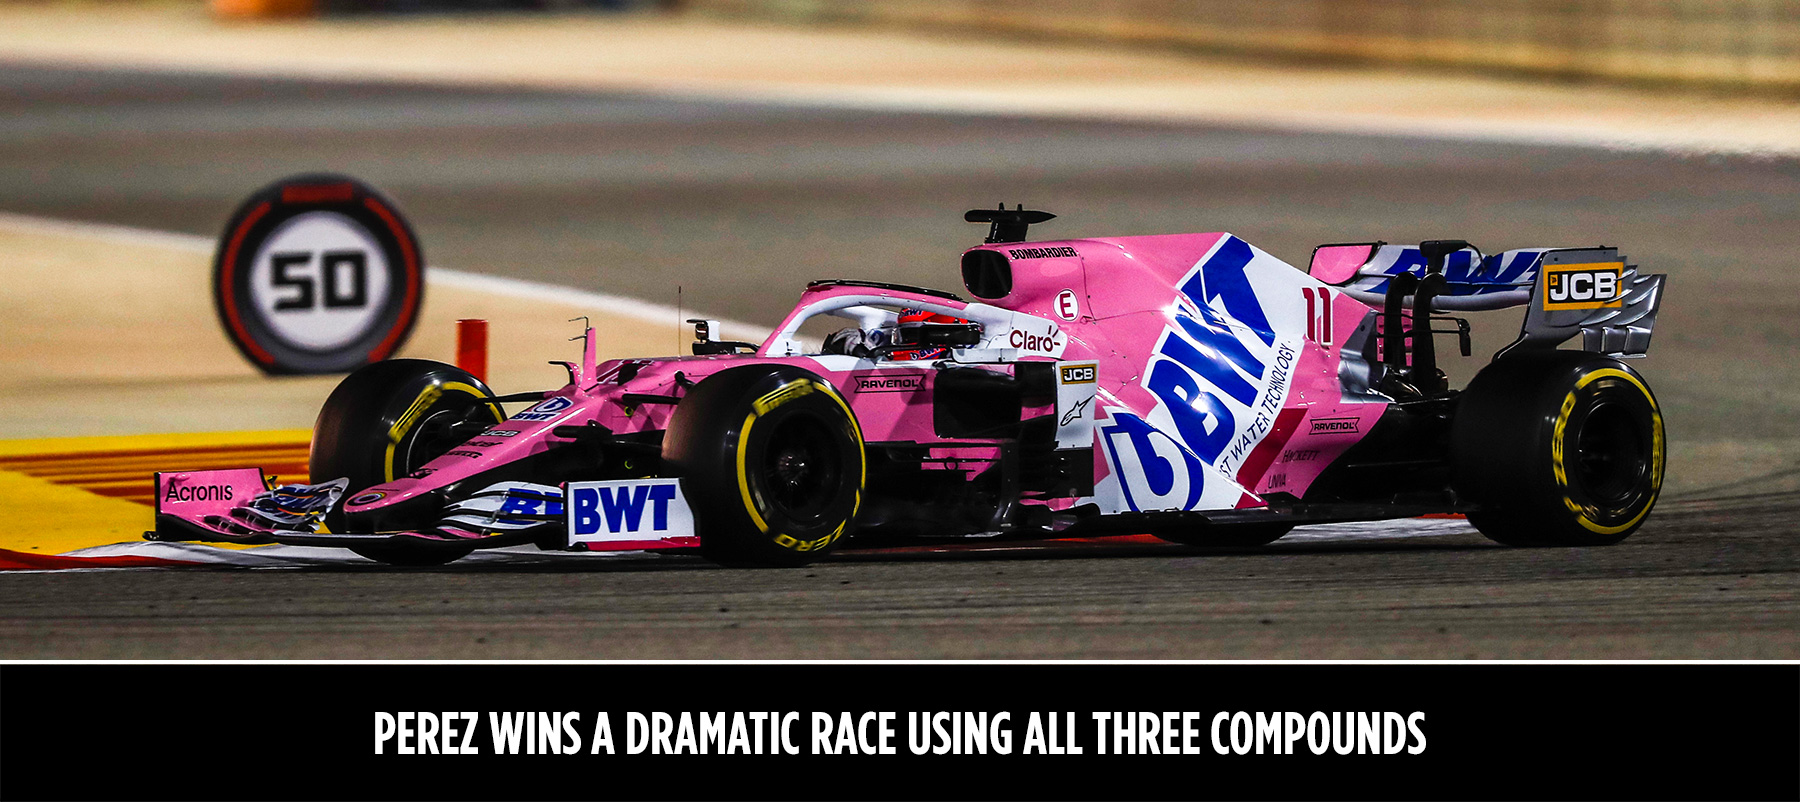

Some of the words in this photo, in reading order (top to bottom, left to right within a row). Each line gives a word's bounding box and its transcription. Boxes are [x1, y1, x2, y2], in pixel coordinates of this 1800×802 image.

[1009, 247, 1077, 259] BOMBARDIER
[270, 252, 367, 311] 50
[1550, 272, 1617, 301] JCB
[1060, 293, 1074, 318] E
[1302, 287, 1333, 343] 11
[1009, 327, 1058, 352] Claro
[1147, 235, 1275, 466] BWT
[861, 379, 919, 389] RAVENOL
[1064, 368, 1094, 381] JCB
[1230, 411, 1271, 461] WATER
[1261, 342, 1296, 415] TECHNOLOGY
[509, 412, 557, 421] BWT
[1313, 422, 1355, 431] RAVENOL
[165, 481, 233, 502] Acronis
[574, 484, 676, 535] BWT
